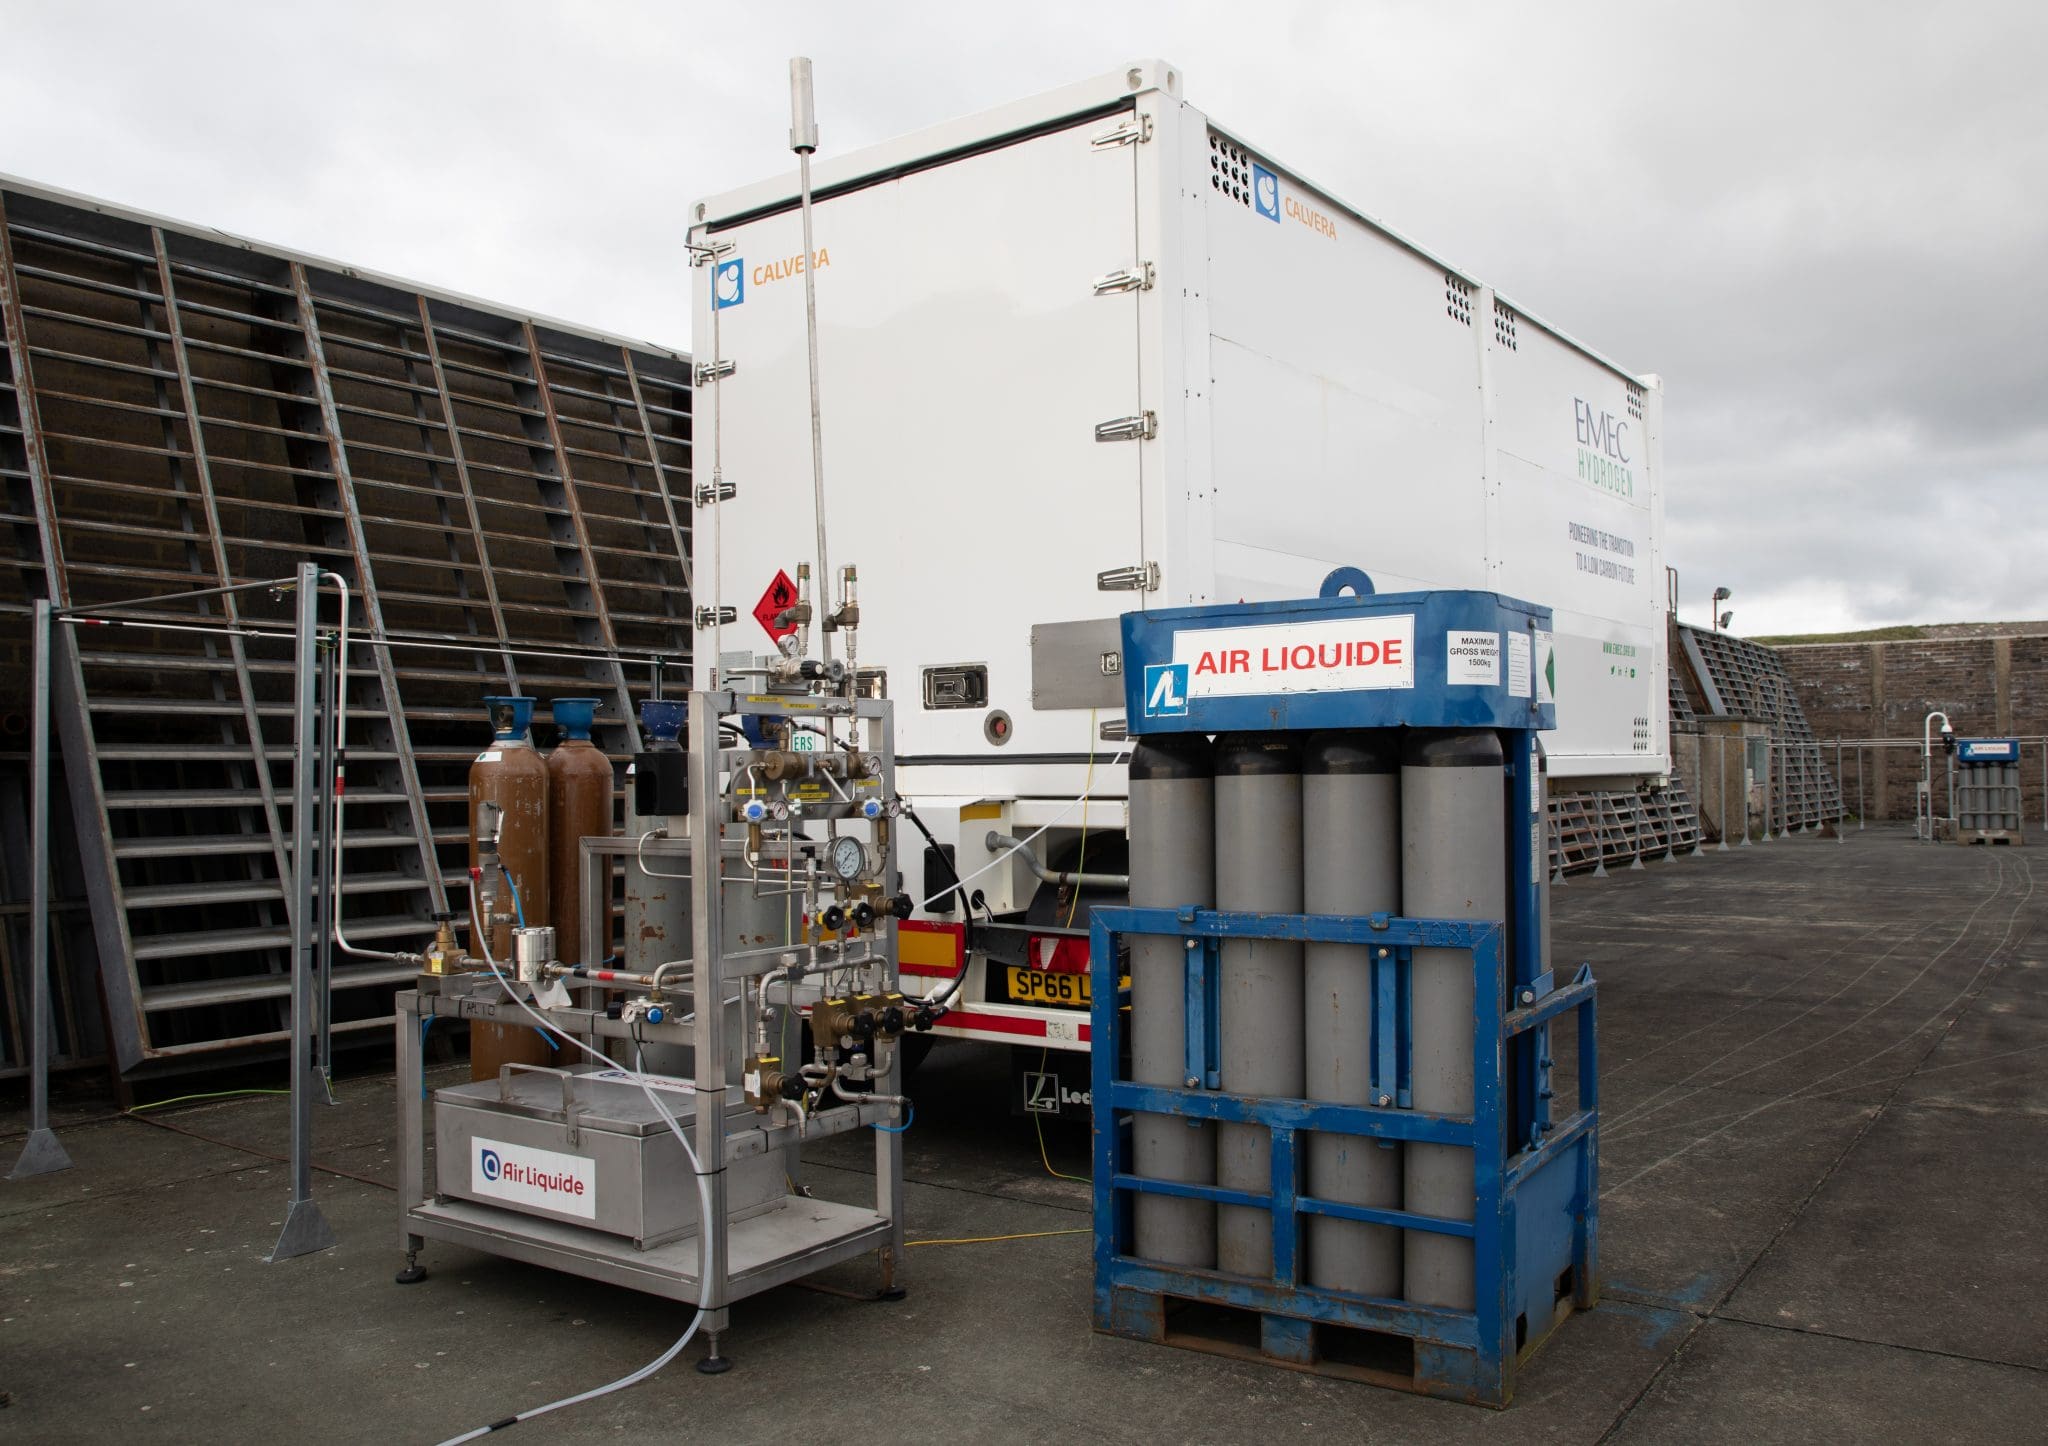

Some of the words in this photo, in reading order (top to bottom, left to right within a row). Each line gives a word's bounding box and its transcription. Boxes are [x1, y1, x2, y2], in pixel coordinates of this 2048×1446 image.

[1285, 196, 1337, 241] CALVERA
[1574, 397, 1631, 464] EMEC
[1577, 448, 1633, 498] HYDROGEN
[1568, 521, 1598, 548] PIONEERING
[1598, 530, 1608, 551] THE
[1608, 533, 1634, 558] TRANSITION
[1576, 552, 1583, 571] TO
[1588, 555, 1599, 576] LOW
[1599, 559, 1618, 581] CARBON
[1618, 564, 1635, 585] FUTURE
[1195, 649, 1250, 675] AIR
[1262, 639, 1402, 672] LIQUIDE
[1449, 647, 1479, 656] GROSS
[1480, 648, 1499, 657] WEIGHT
[1461, 637, 1495, 646] MAXIMUM
[1468, 658, 1491, 668] 1500kg
[1016, 971, 1072, 999] SP66
[503, 1162, 524, 1182] Air
[526, 1166, 584, 1195] Liquide
